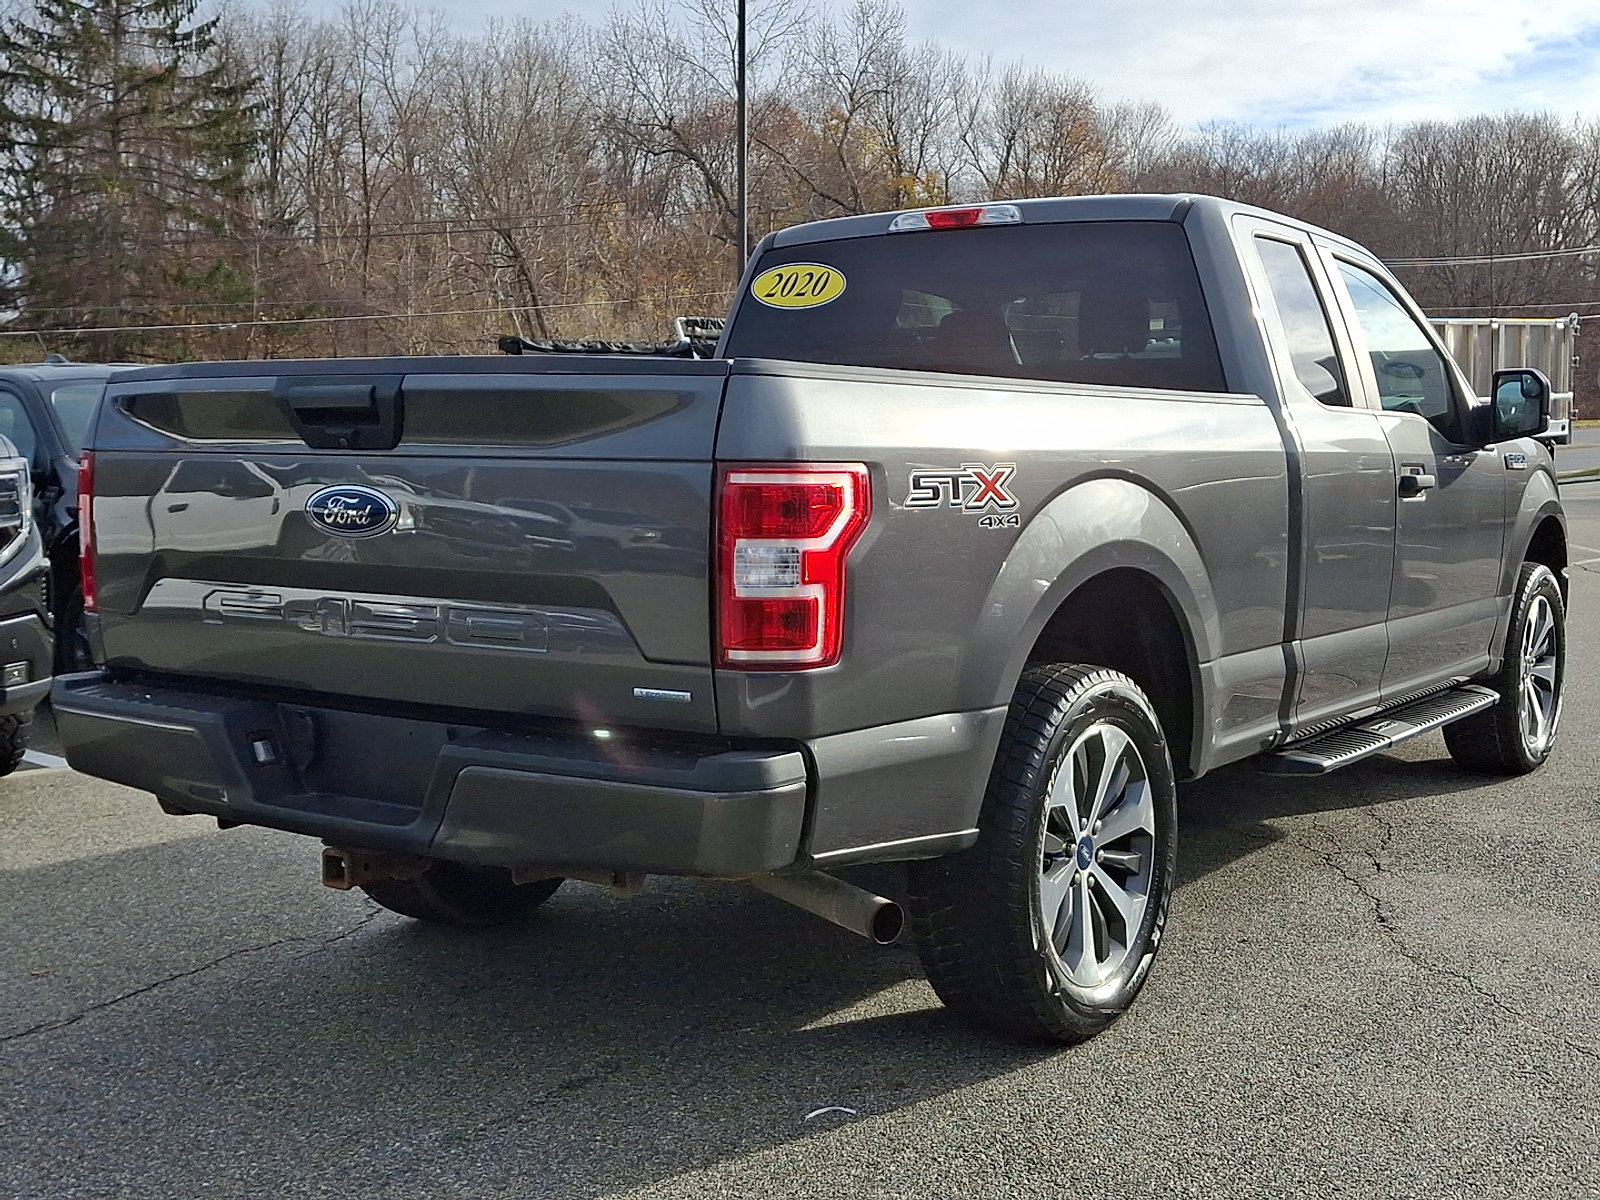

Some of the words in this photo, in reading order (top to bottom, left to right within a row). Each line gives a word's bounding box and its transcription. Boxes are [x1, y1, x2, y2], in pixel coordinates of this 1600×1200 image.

[763, 270, 830, 298] 2020
[903, 462, 1020, 514] STX
[324, 495, 372, 524] Ford
